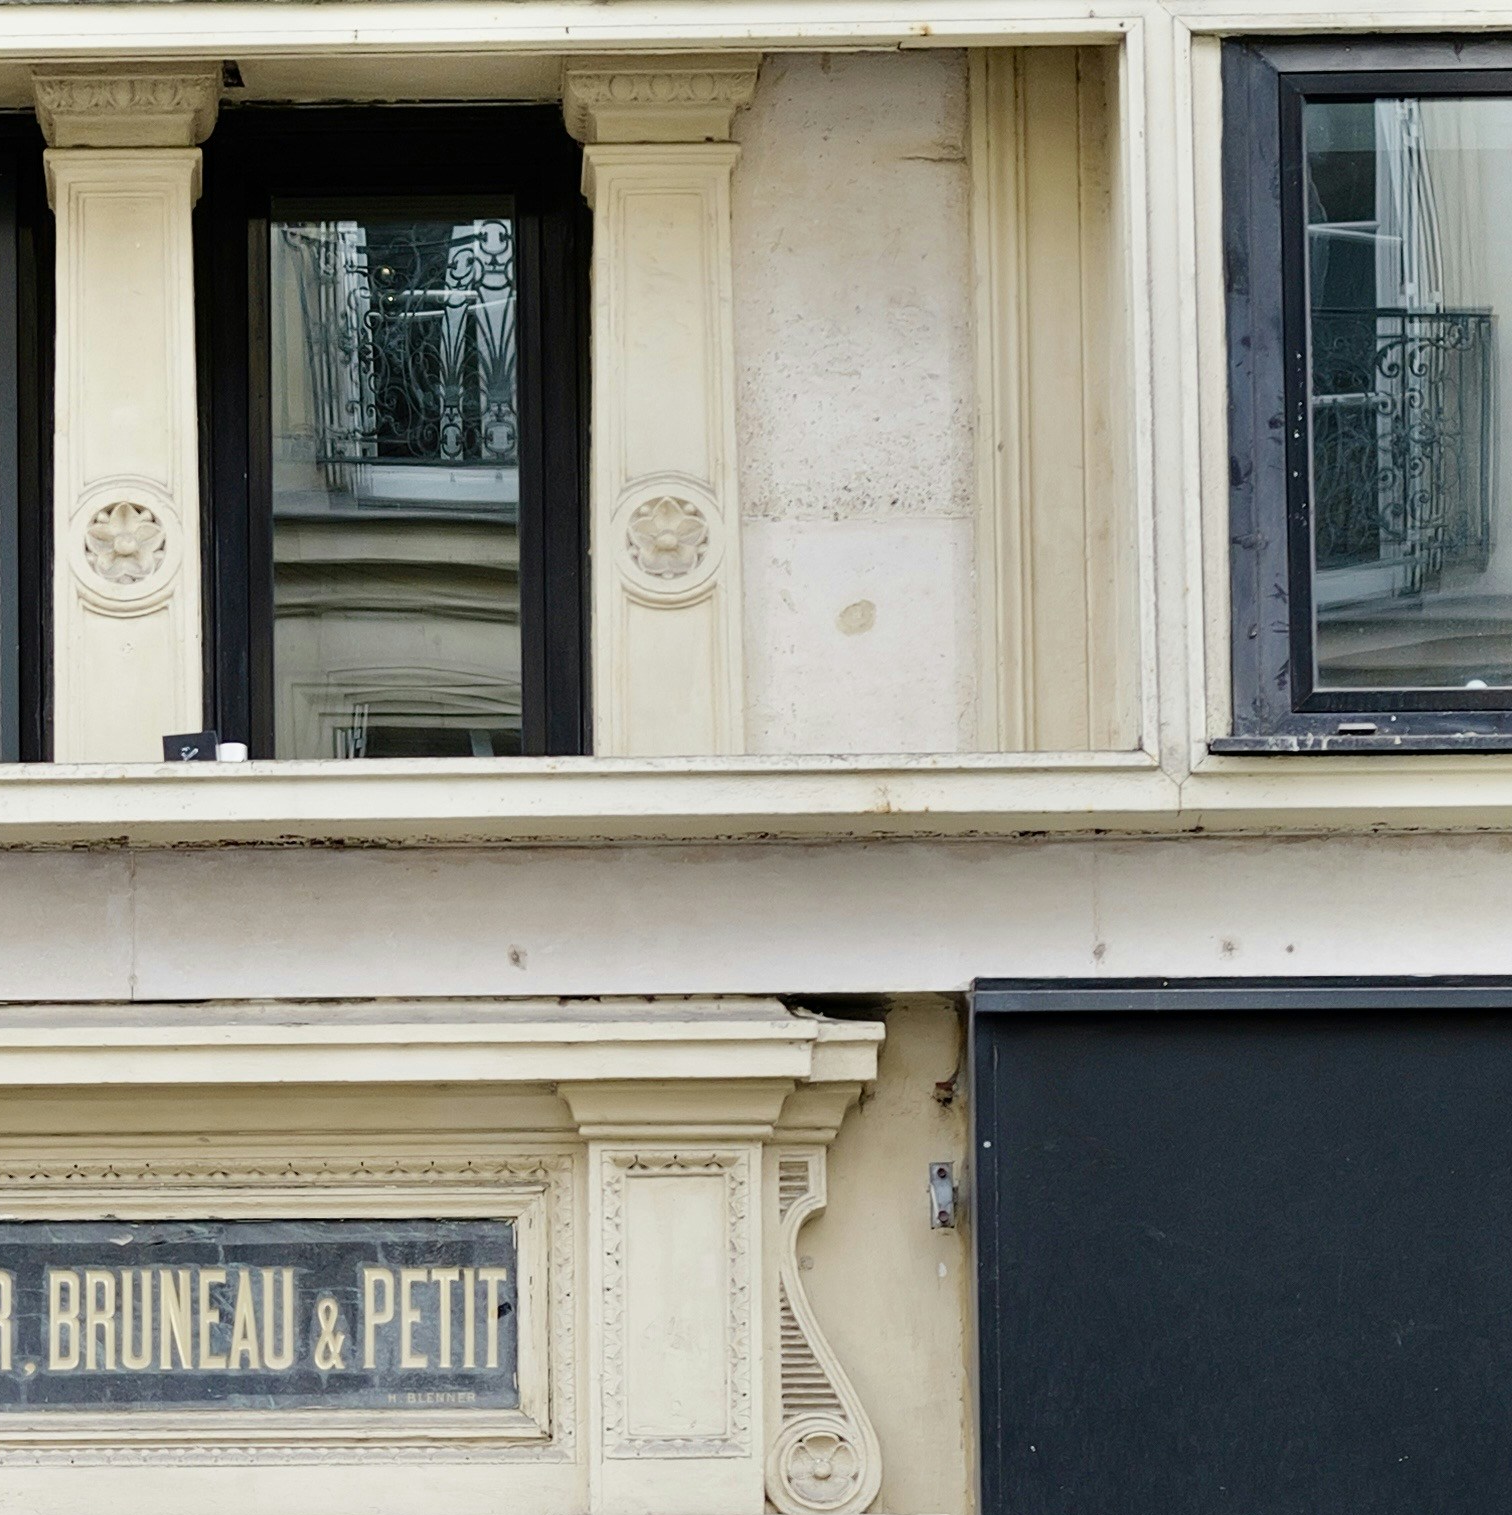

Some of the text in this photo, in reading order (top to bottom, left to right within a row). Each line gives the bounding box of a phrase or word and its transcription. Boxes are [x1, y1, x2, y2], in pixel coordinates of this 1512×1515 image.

[49, 1268, 295, 1371] BRUNEAU
[313, 1295, 347, 1372] &
[364, 1266, 508, 1370] PETIT
[407, 1392, 476, 1404] BLENNER
